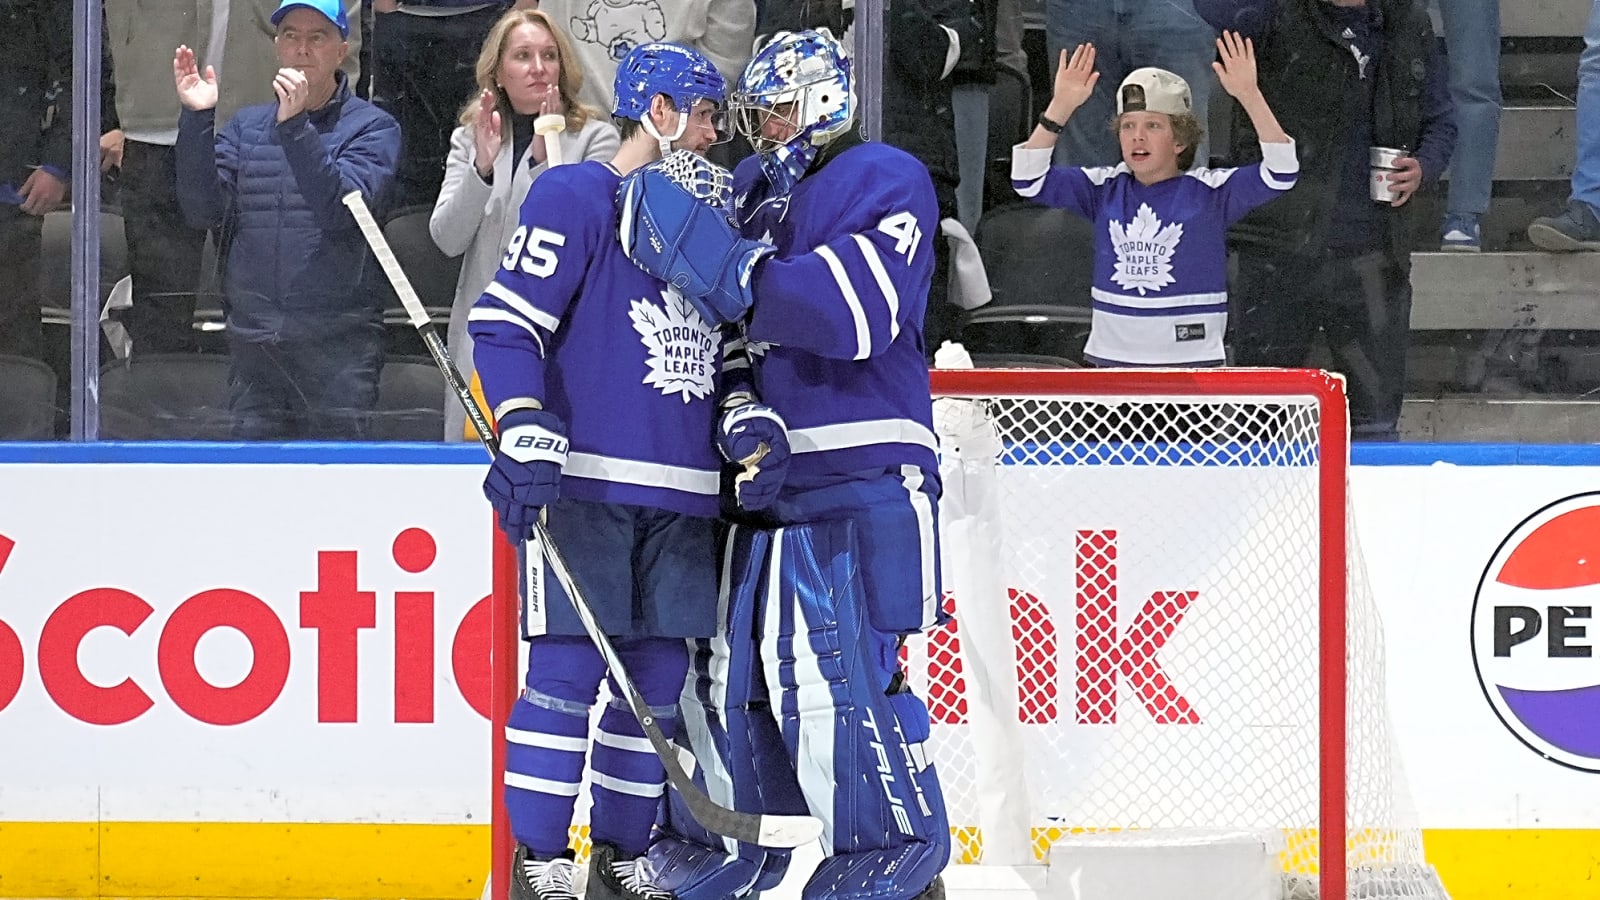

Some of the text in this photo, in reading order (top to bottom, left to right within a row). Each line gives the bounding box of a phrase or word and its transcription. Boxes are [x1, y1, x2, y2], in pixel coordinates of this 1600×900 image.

[878, 211, 922, 266] 41
[502, 225, 566, 279] 95
[1119, 241, 1167, 256] TORONTO
[1126, 255, 1158, 264] MAPLE
[1125, 265, 1159, 275] LEAFS
[653, 326, 712, 352] TORONTO
[664, 345, 705, 361] MAPLE
[664, 360, 705, 376] LEAFS
[862, 706, 914, 836] TRUE
